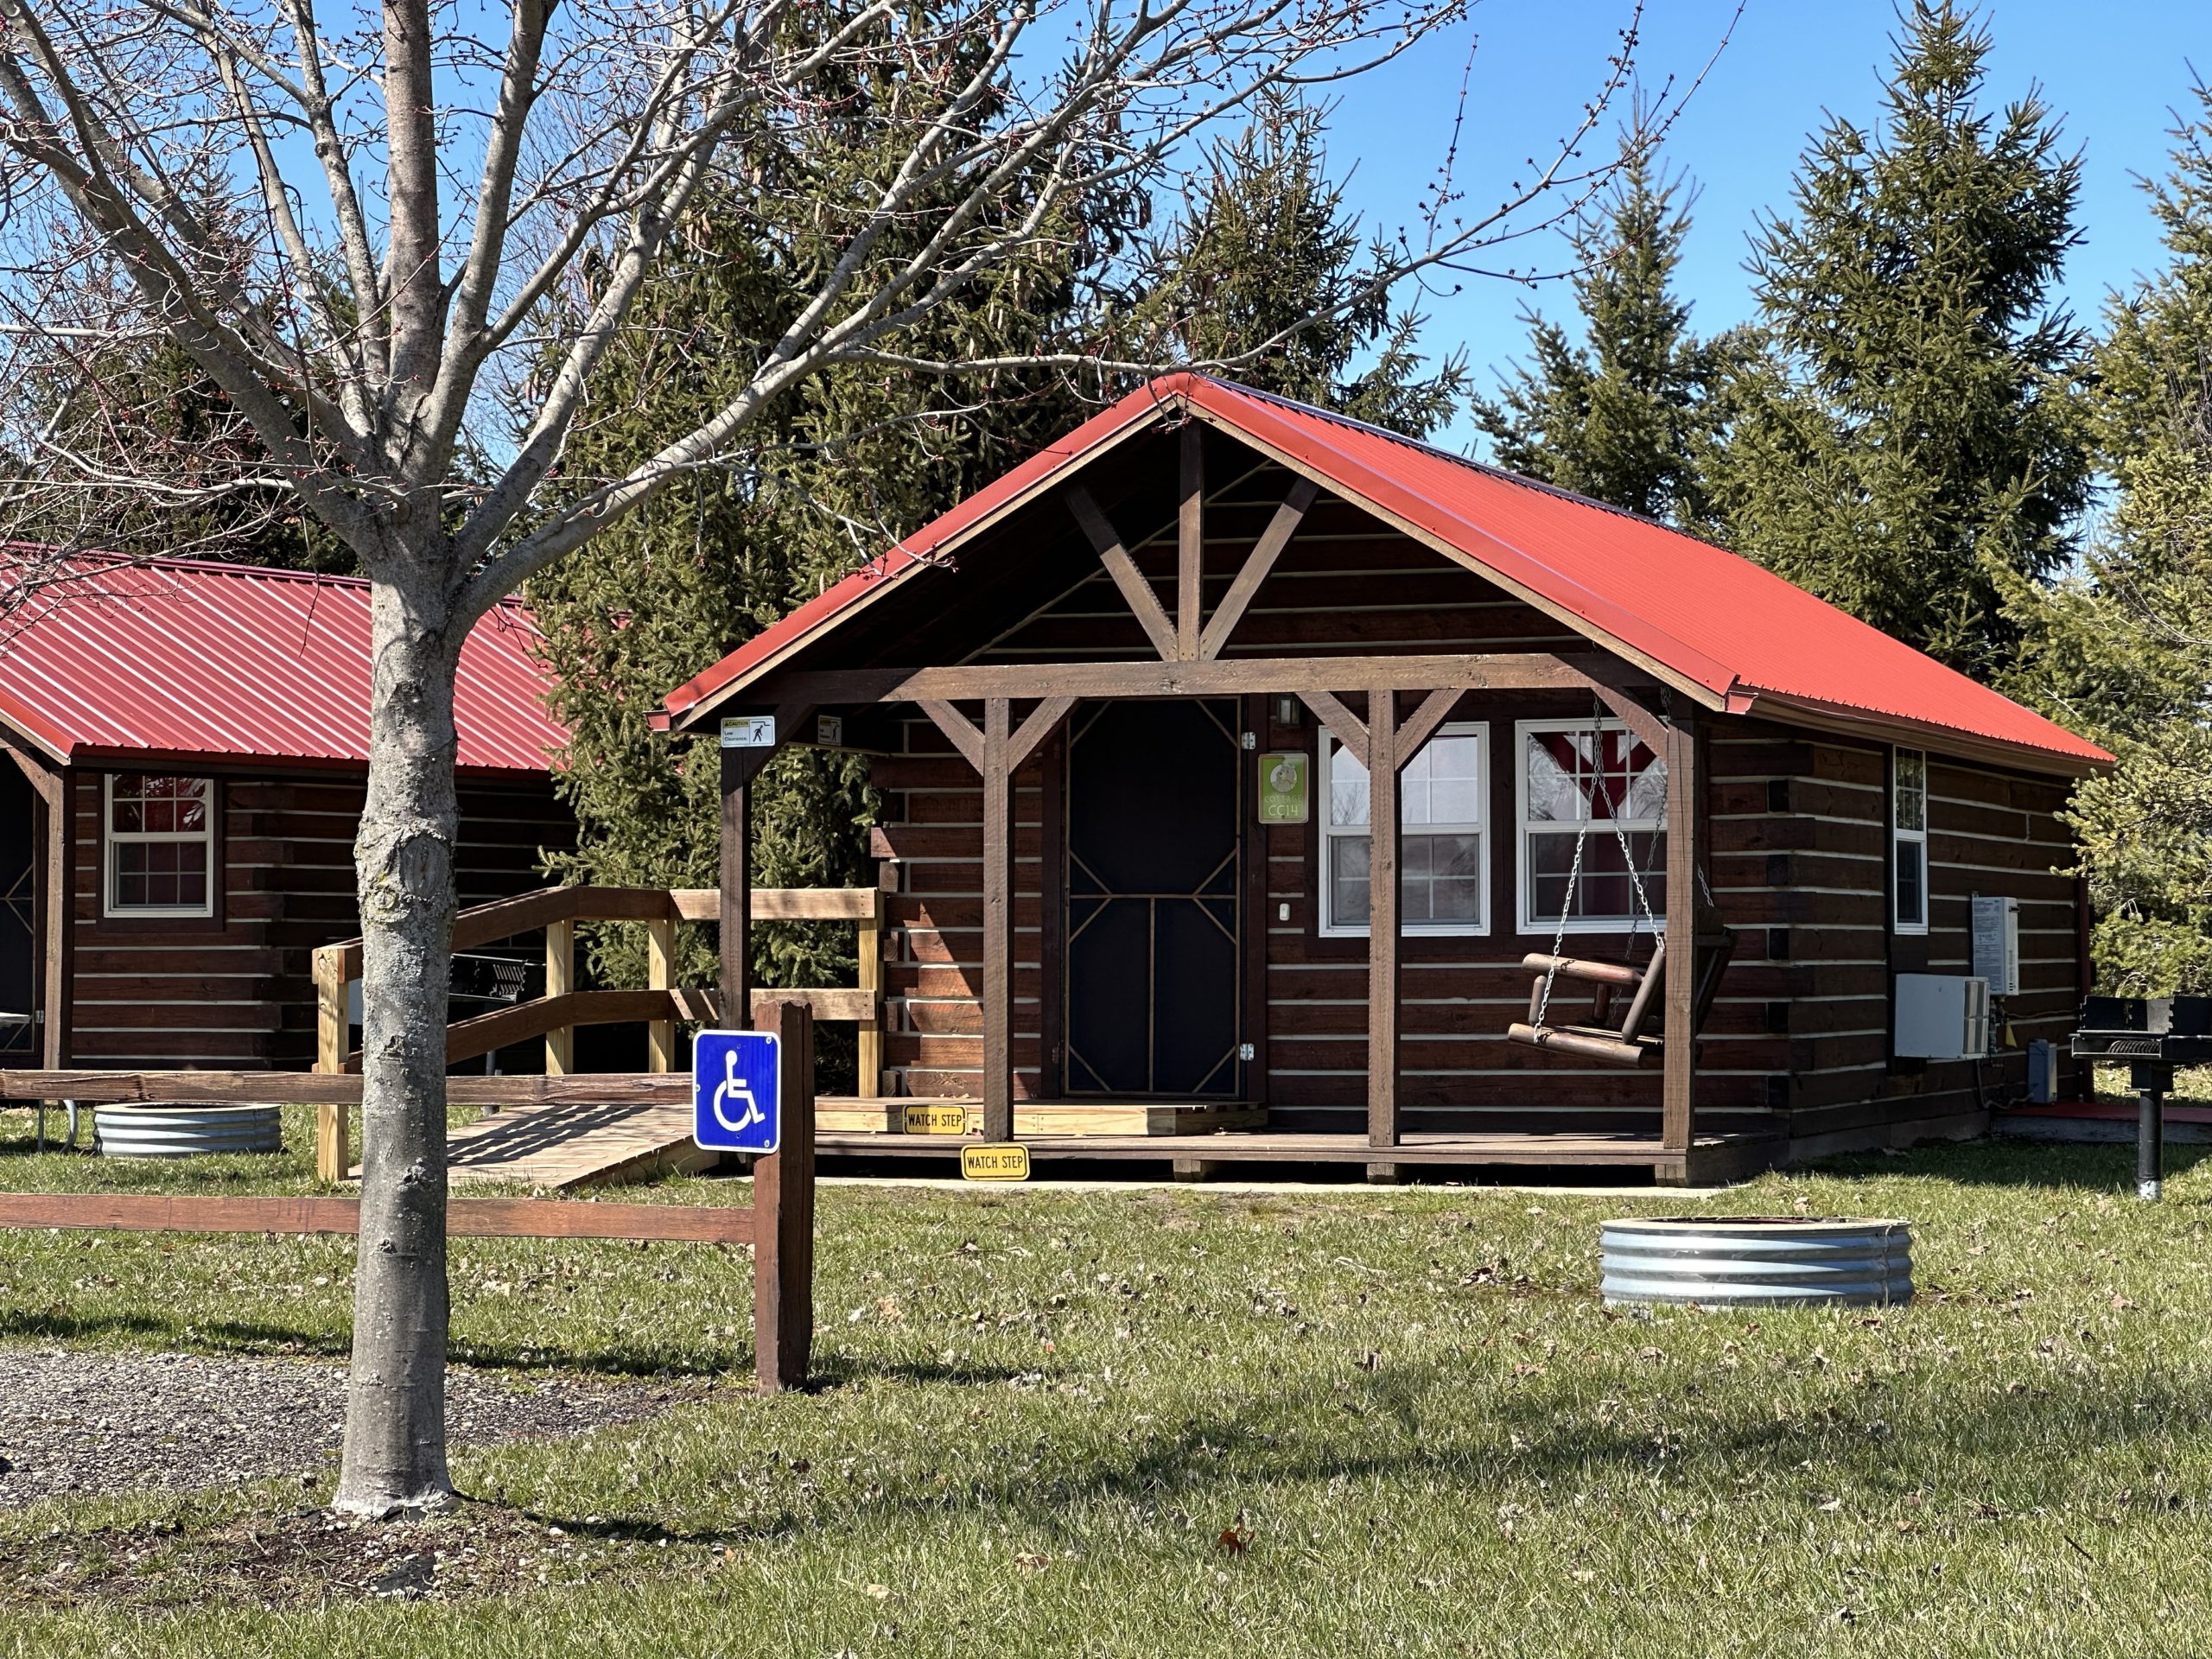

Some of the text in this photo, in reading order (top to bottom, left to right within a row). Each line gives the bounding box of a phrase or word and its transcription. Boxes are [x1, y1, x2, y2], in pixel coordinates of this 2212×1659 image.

[1268, 804, 1298, 817] CC14
[908, 1114, 962, 1127] WATCH STEP
[967, 1155, 1023, 1169] WATCH STEP
